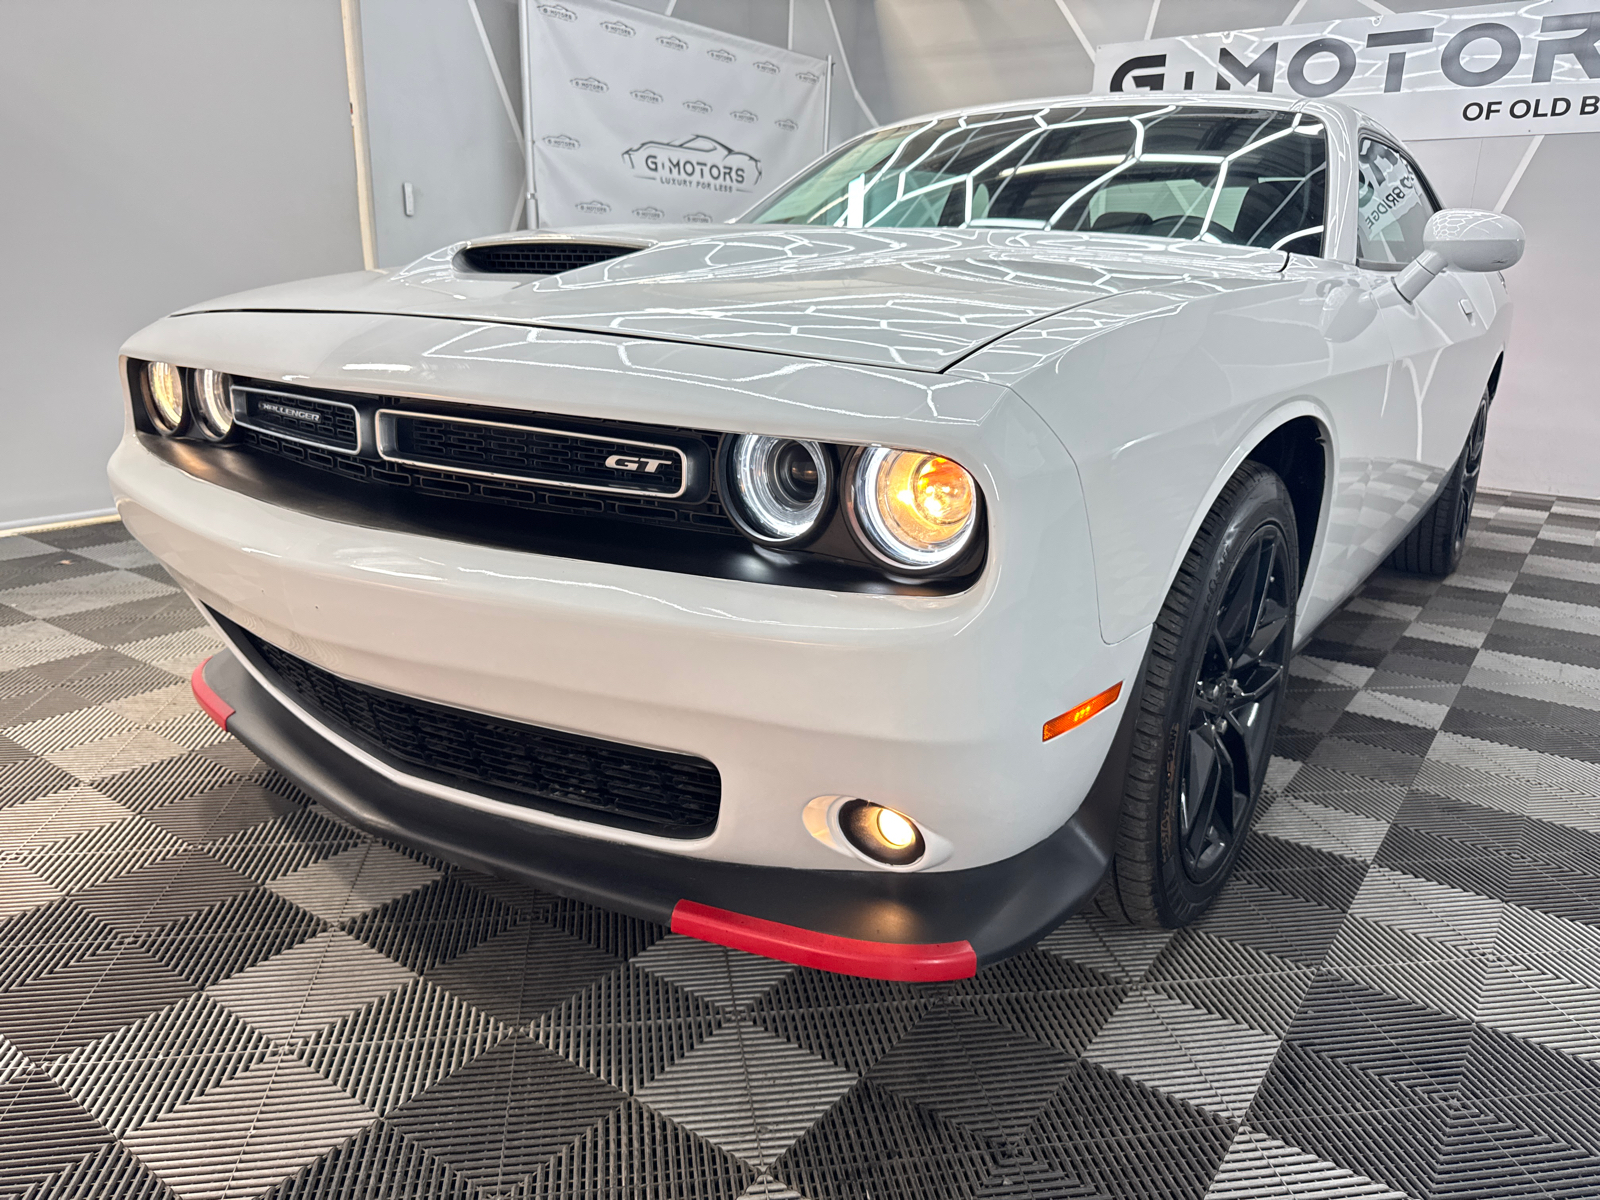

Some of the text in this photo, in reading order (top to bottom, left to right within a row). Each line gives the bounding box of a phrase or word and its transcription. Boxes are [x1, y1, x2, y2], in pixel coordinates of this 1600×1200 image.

[1462, 101, 1502, 121] OF
[1509, 97, 1571, 119] OLD
[660, 177, 734, 194] LUXURY FOR LESS
[605, 454, 672, 473] GT
